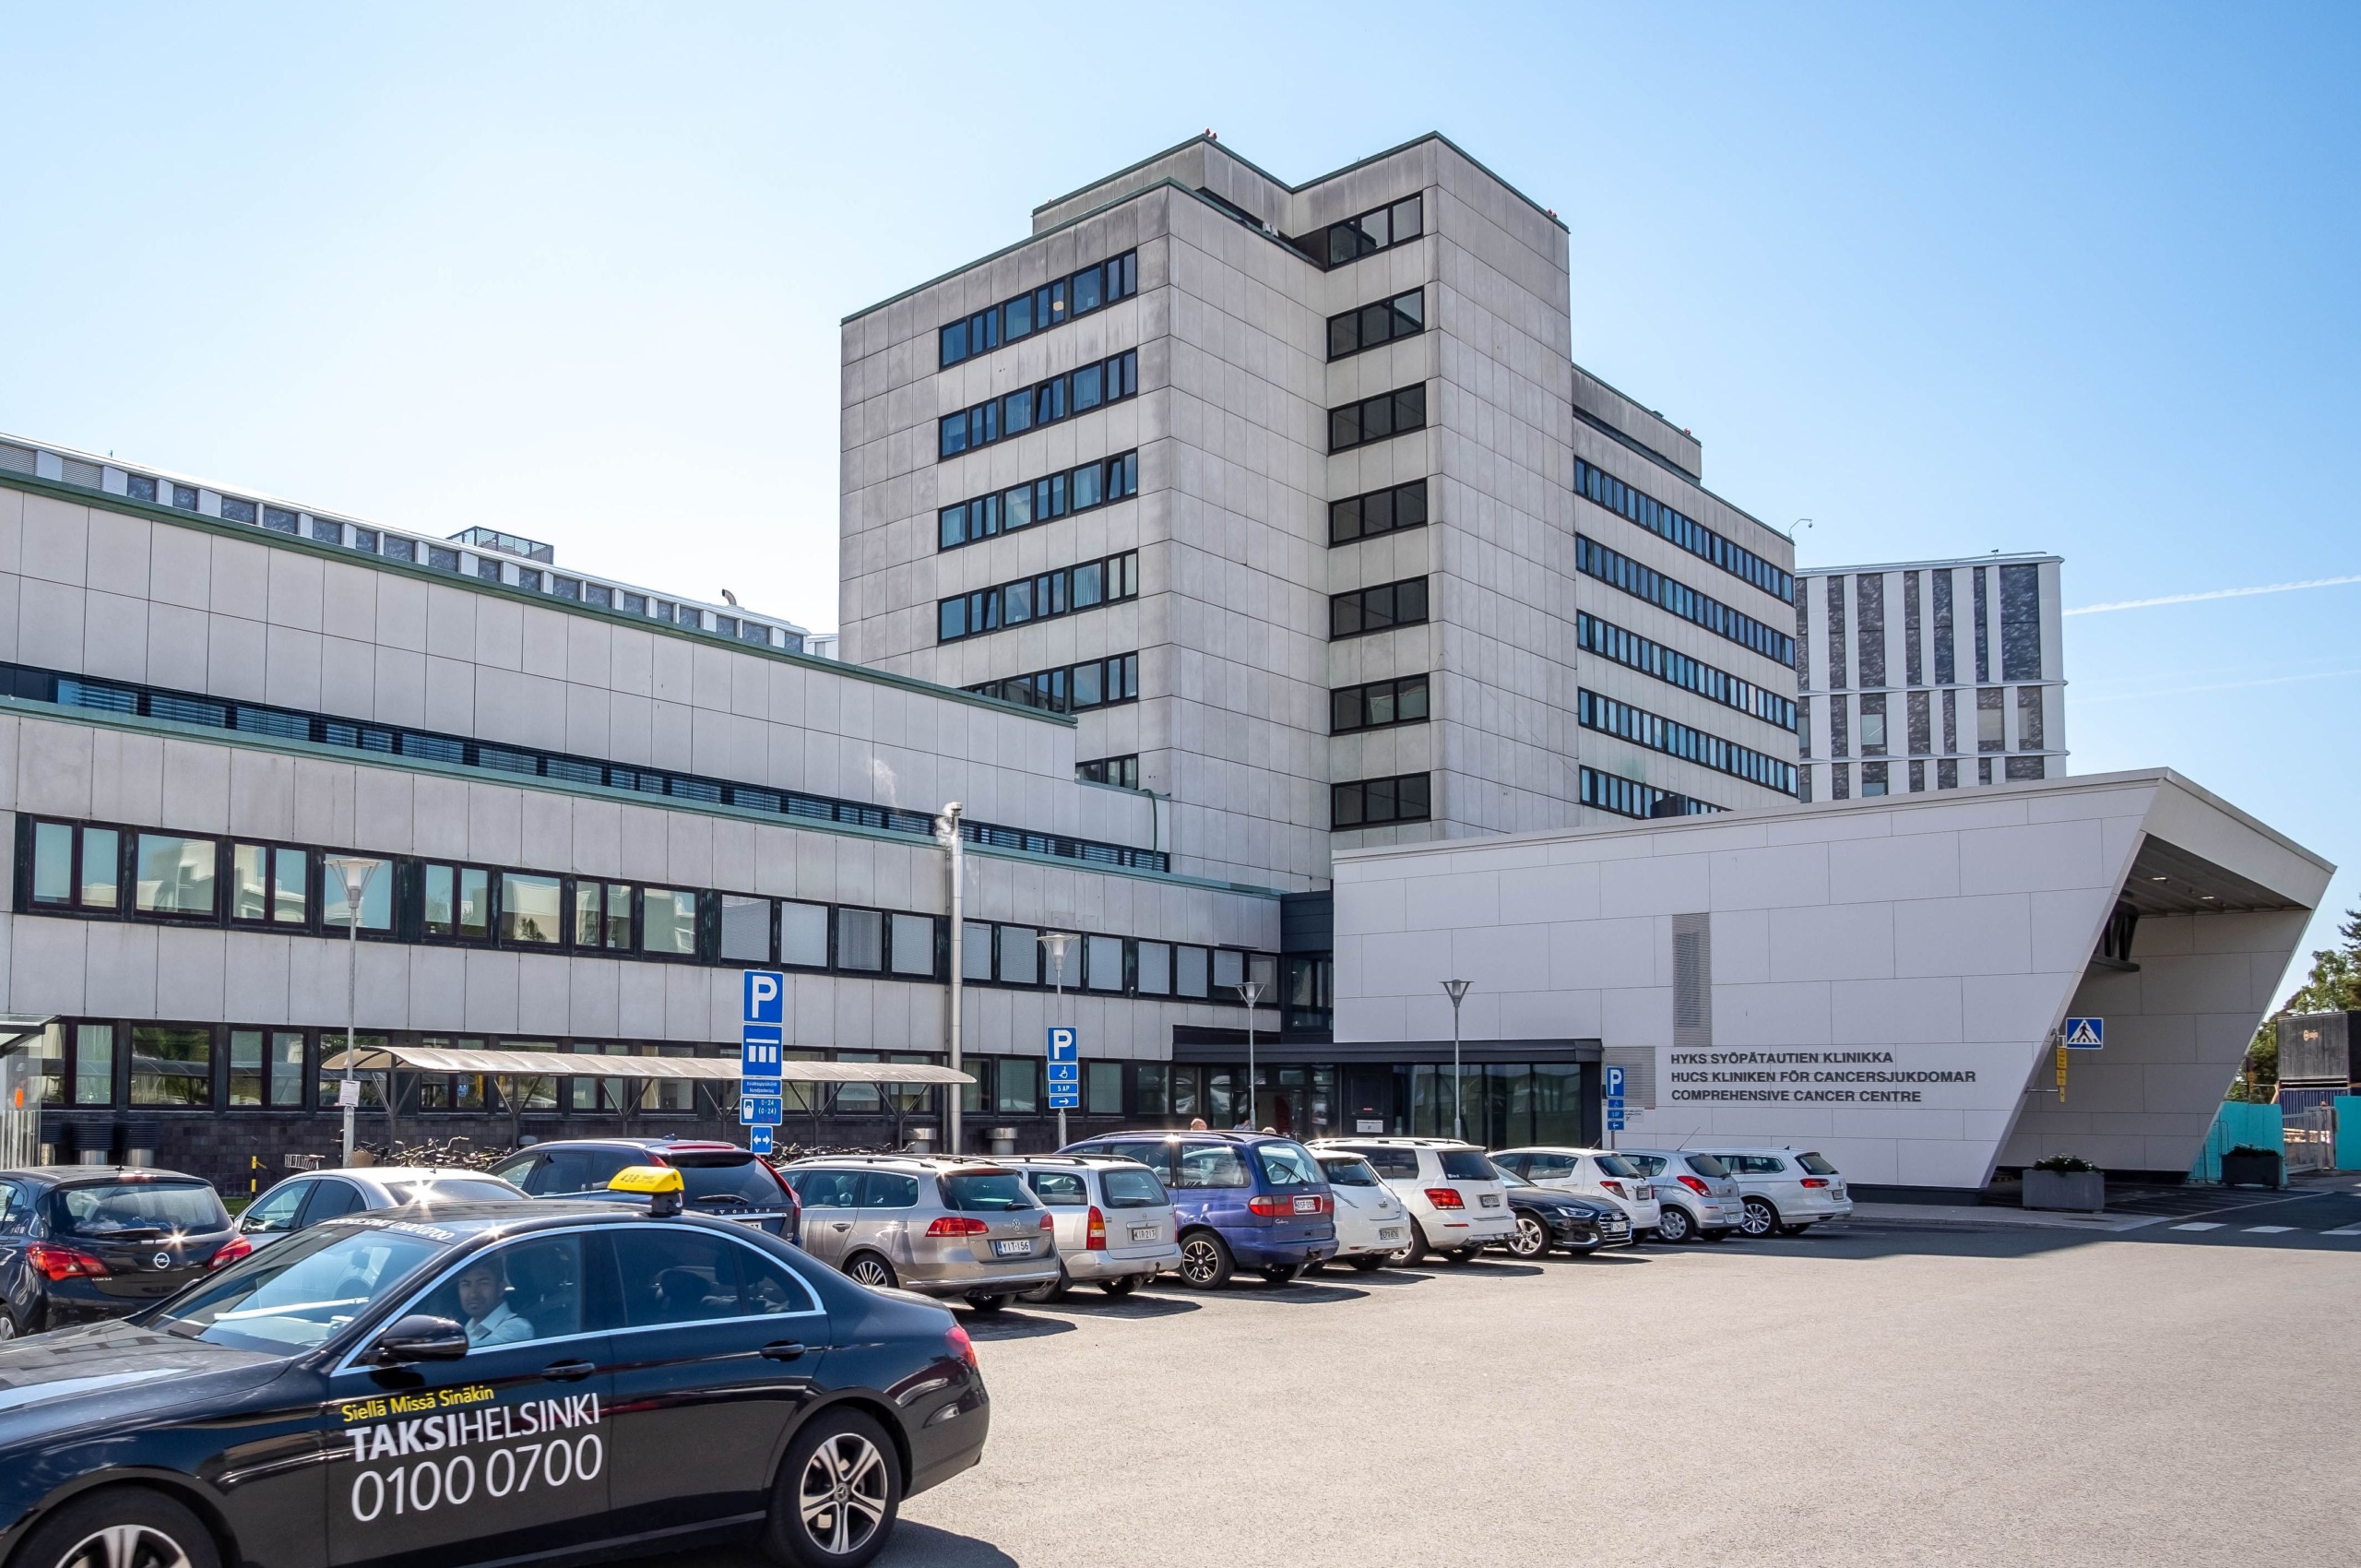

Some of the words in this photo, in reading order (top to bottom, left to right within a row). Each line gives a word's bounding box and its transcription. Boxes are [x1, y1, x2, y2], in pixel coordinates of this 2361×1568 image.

[752, 975, 777, 1018] P
[1053, 1029, 1073, 1060] P
[1671, 1053, 1707, 1064] HYKS
[1711, 1051, 1819, 1064] SYÖPÄTAUTIEN
[1823, 1051, 1893, 1063] KLINIKKA
[1610, 1069, 1622, 1095] P
[1671, 1072, 1708, 1083] HUCS
[1712, 1071, 1776, 1082] KLINIKEN
[1780, 1069, 1810, 1083] FÖR
[1813, 1071, 1976, 1083] CANCERSJUKDOMAR
[1671, 1089, 1790, 1101] COMPREHENSIVE
[1794, 1090, 1856, 1102] CANCER
[1859, 1090, 1921, 1102] CENTRE
[1003, 1241, 1029, 1252] YIT-156
[341, 1400, 386, 1423] Siellä
[390, 1393, 436, 1415] Missä
[438, 1384, 494, 1408] Sinäkin
[345, 1392, 600, 1463] TAKSIHELSINKI
[351, 1455, 476, 1522] 0100
[485, 1433, 603, 1497] 0700
